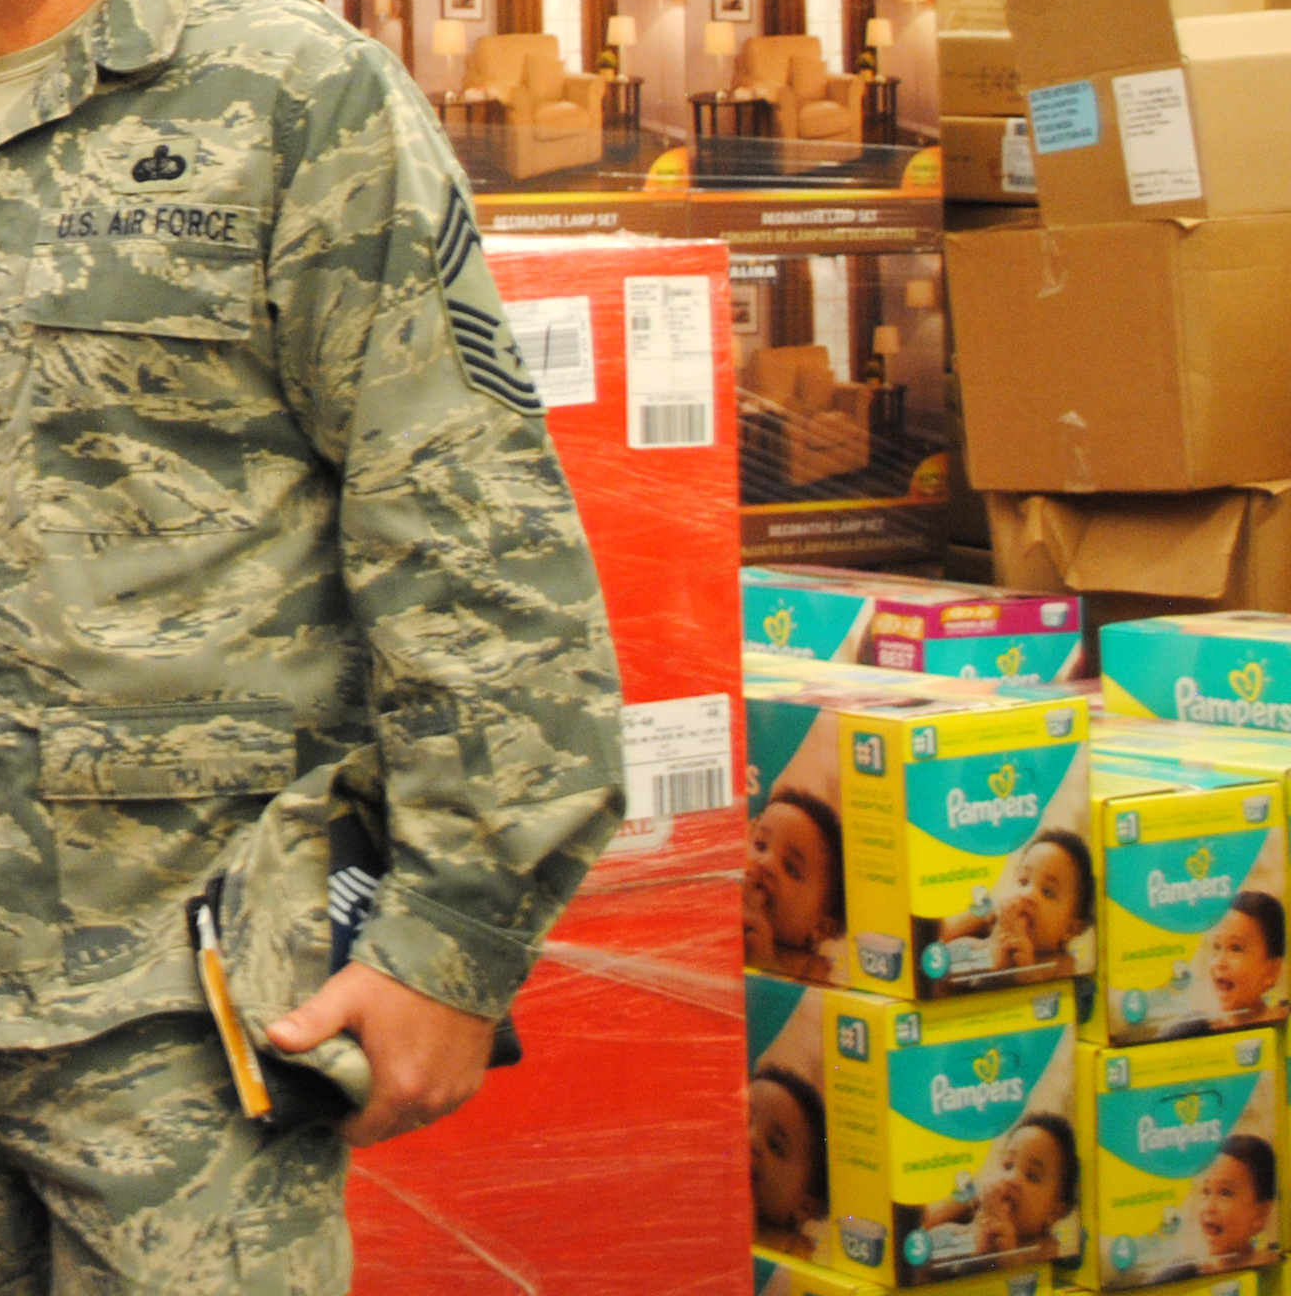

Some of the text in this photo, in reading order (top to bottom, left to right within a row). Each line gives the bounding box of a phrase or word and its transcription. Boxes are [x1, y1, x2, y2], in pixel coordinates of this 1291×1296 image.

[57, 208, 237, 241] U.S. AIR FORCE
[563, 213, 594, 228] LAMP
[597, 212, 618, 227] SET
[730, 264, 777, 278] ALINA
[1175, 676, 1291, 731] Pampers
[855, 735, 882, 771] #1
[913, 727, 936, 757] #1
[947, 788, 1039, 829] Pampers
[1147, 869, 1232, 908] Pampers
[930, 944, 943, 970] 3
[930, 1074, 1023, 1115] Pampers
[1138, 1114, 1222, 1153] Pampers
[912, 1232, 925, 1256] 3
